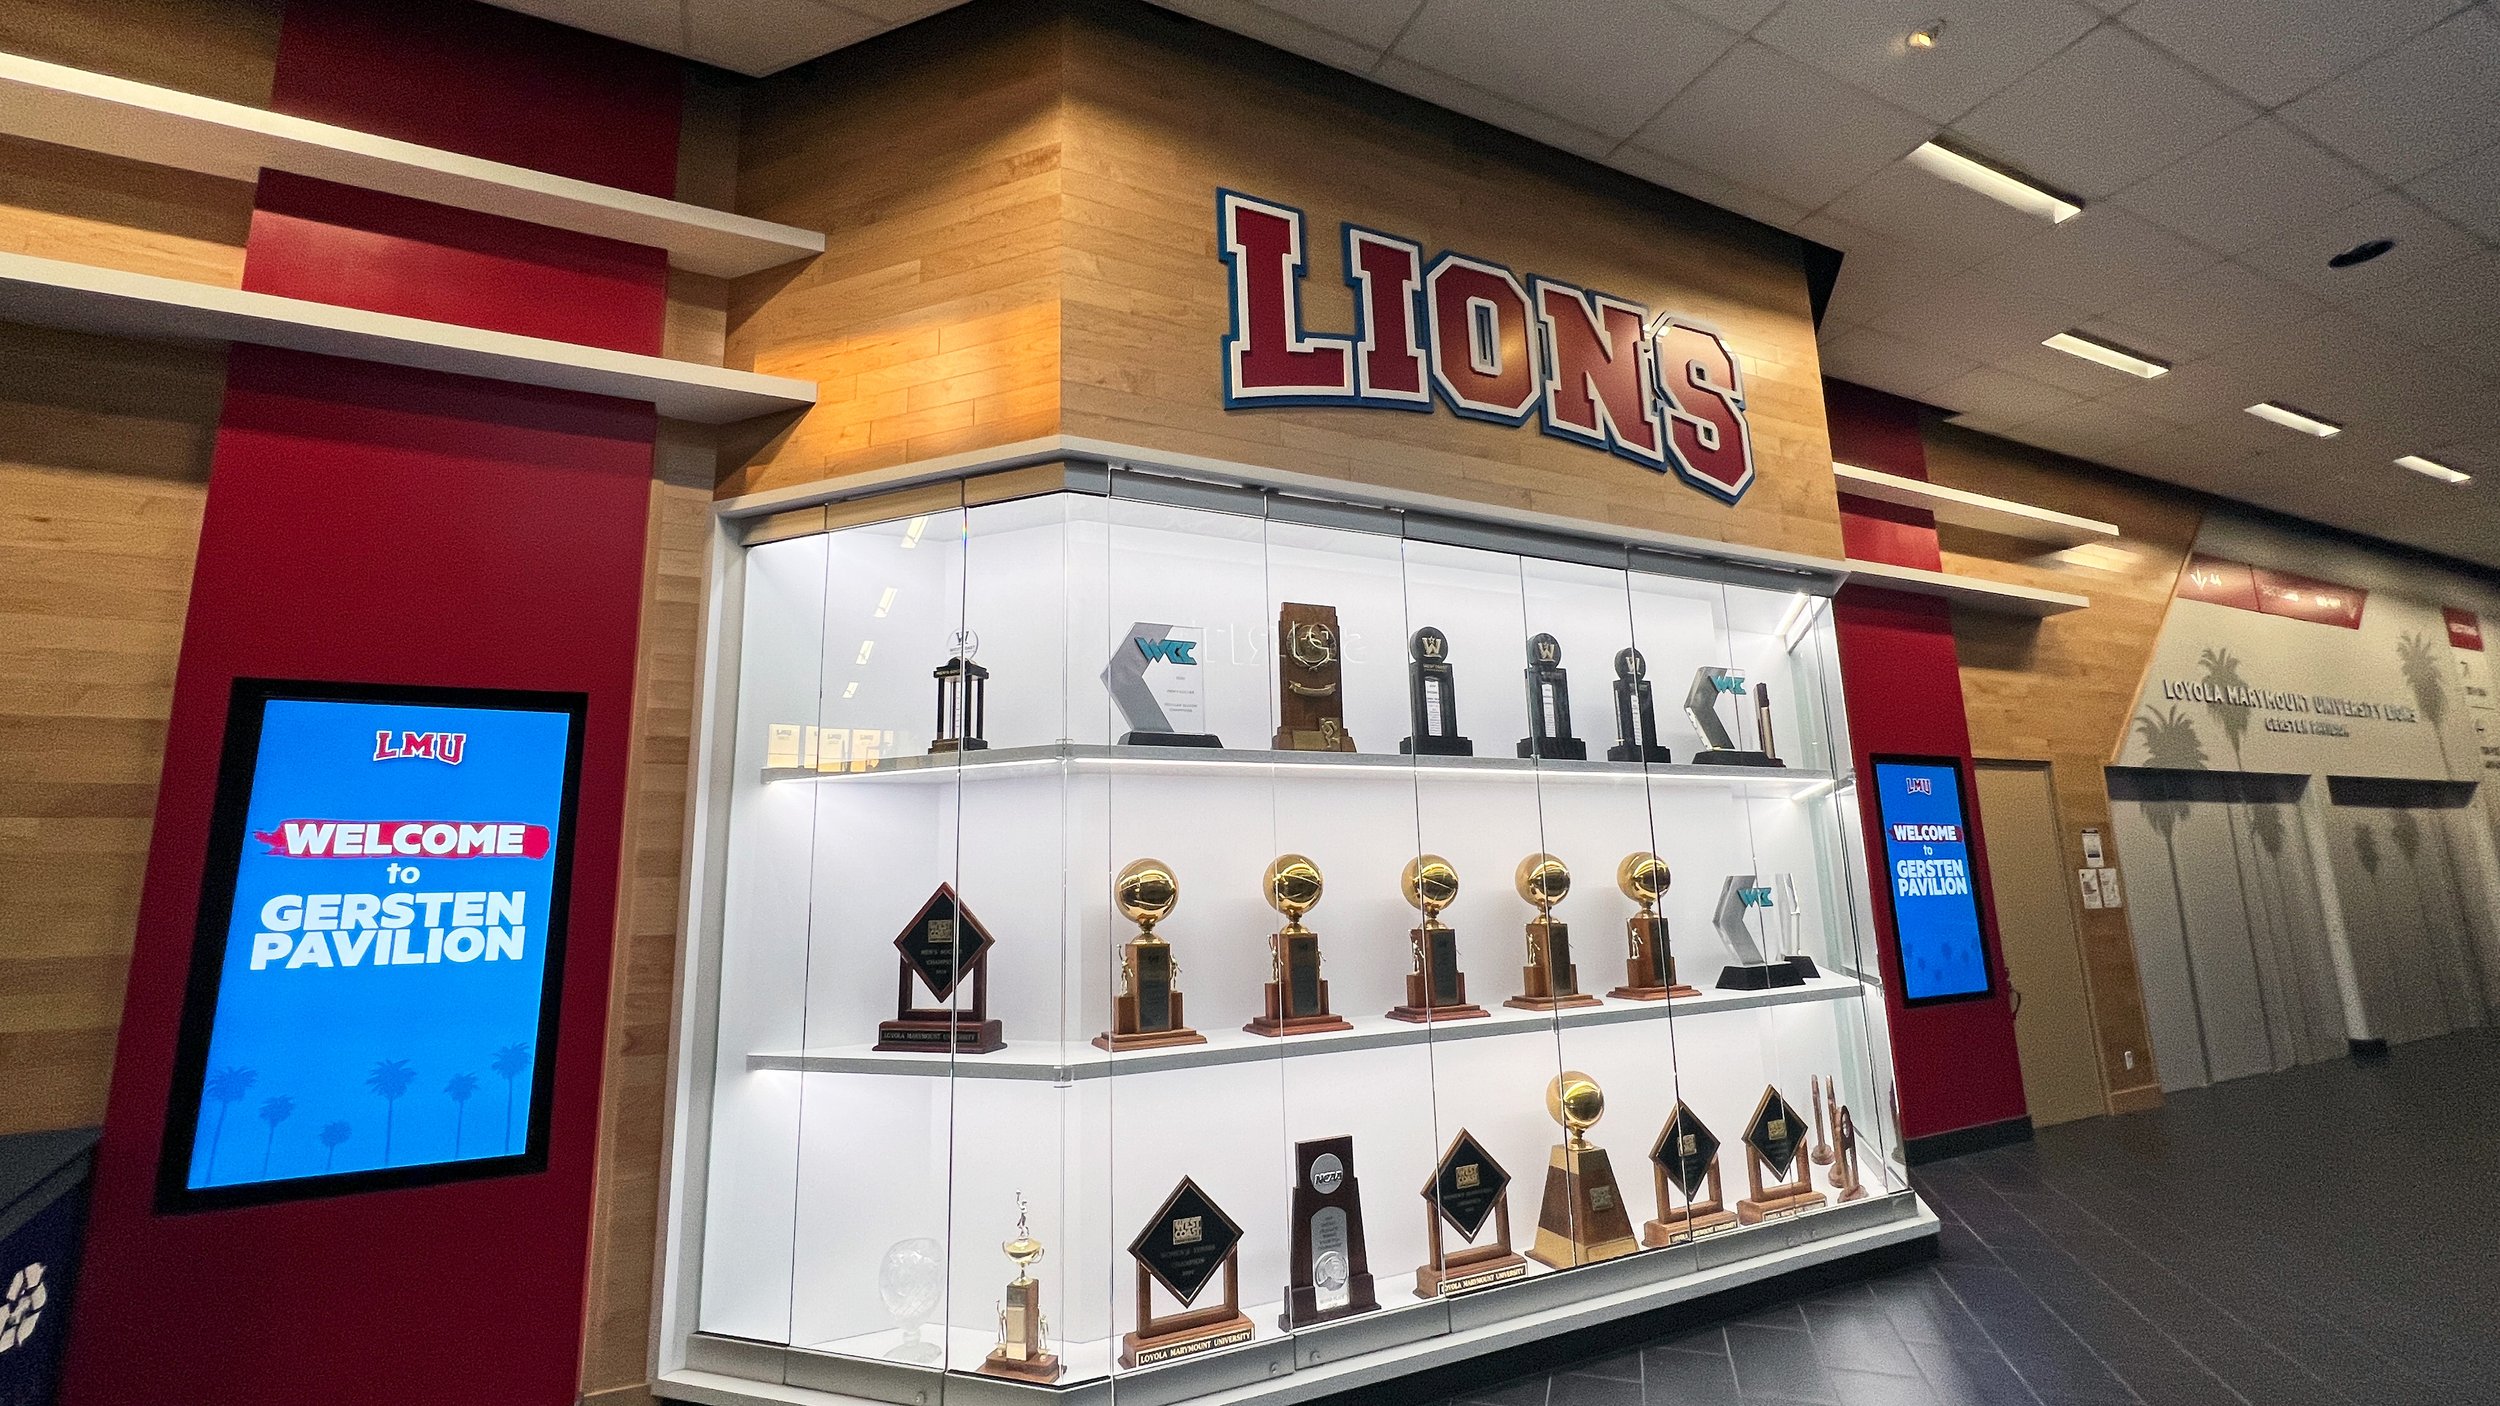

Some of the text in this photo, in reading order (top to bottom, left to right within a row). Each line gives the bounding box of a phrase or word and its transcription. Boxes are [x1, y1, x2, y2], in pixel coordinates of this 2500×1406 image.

[1217, 187, 1756, 505] LIONS
[1134, 637, 1197, 665] WCC
[2163, 679, 2222, 703] LOYOLA
[2226, 686, 2309, 712] MARYMOUNT
[373, 730, 466, 765] LMU
[1906, 778, 1931, 795] LMU
[284, 823, 526, 856] WELCOME
[1893, 825, 1957, 841] WELCOME
[1923, 844, 1933, 856] to
[386, 862, 421, 885] to
[1896, 859, 1964, 879] GERSTEN
[1898, 877, 1968, 897] PAVILION
[260, 891, 526, 932] GERSTEN
[249, 926, 526, 971] PAVILION
[1140, 1332, 1251, 1364] LOYOLA MARYMOUNT UNIVERSITY
